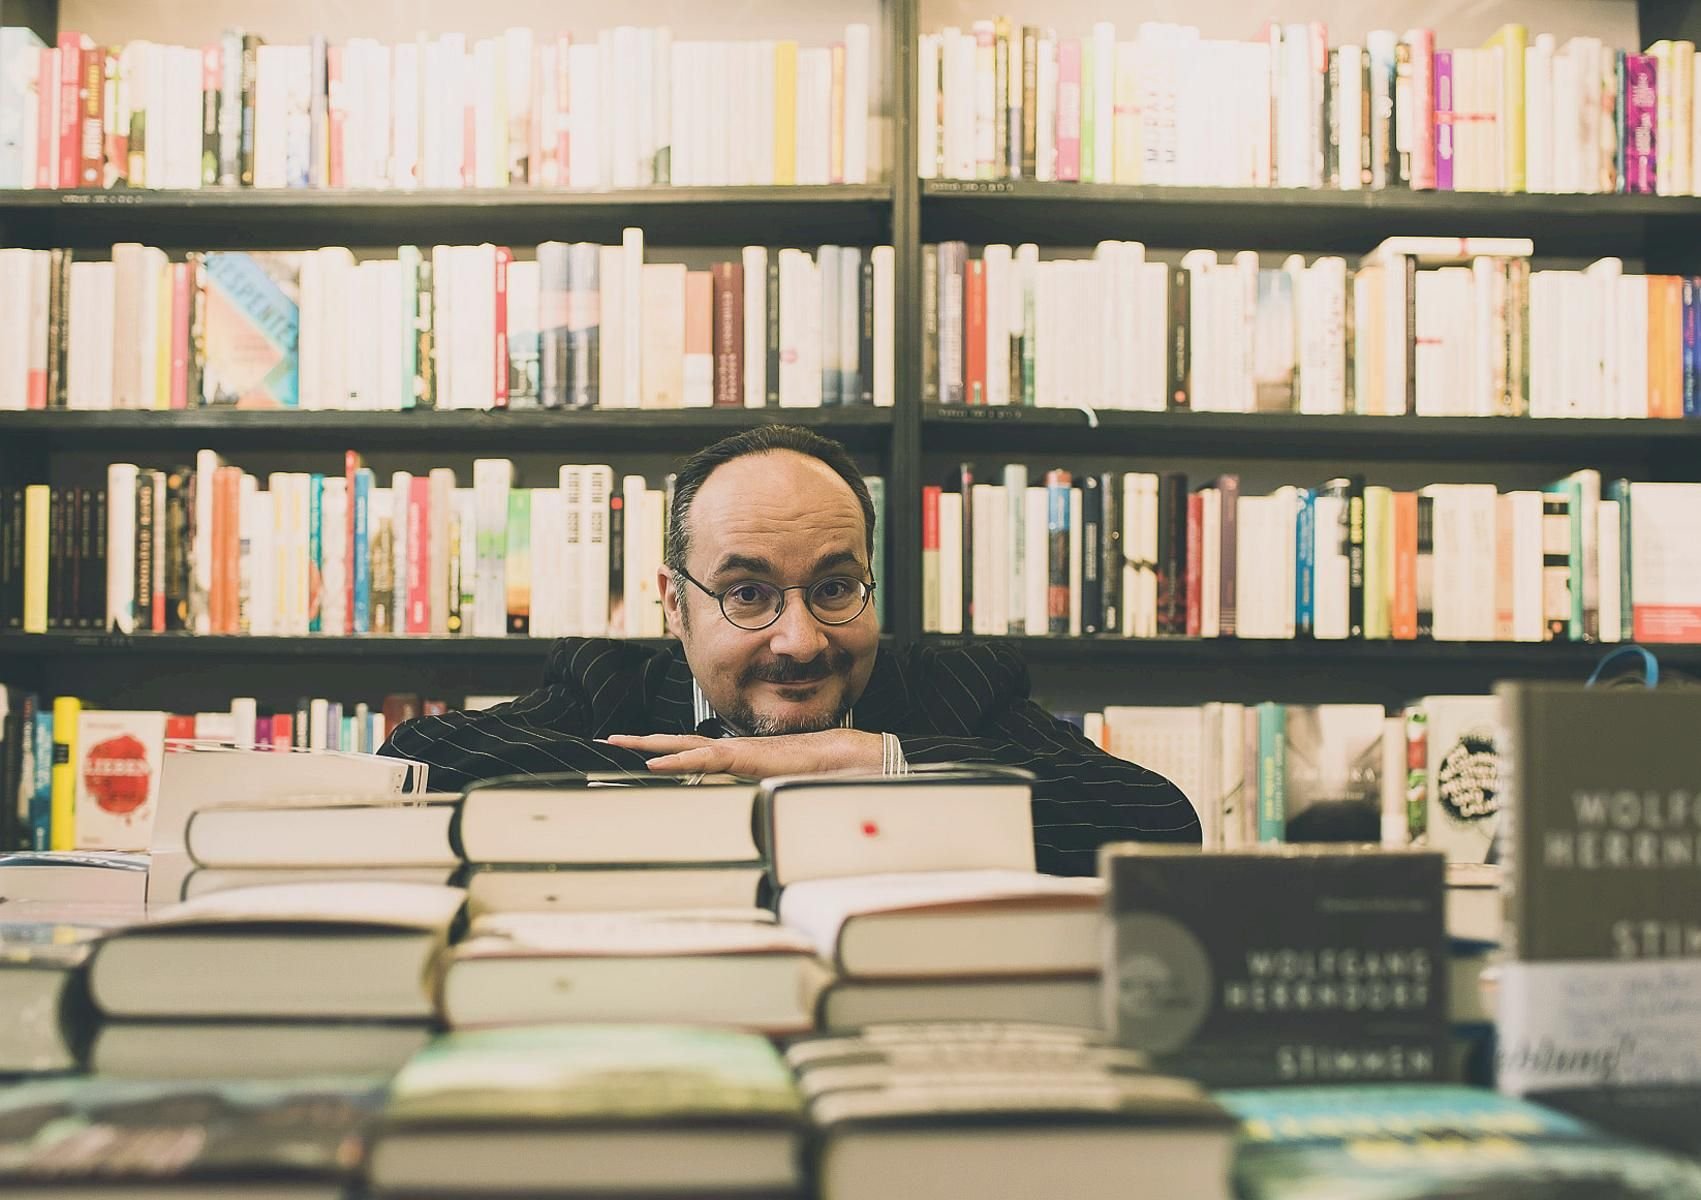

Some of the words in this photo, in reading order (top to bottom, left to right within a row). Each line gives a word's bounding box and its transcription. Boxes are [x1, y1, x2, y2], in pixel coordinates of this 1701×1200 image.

[1544, 831, 1701, 868] HERRN
[1247, 949, 1431, 979] WOLFGANG
[1225, 981, 1428, 1010] HERRNDORF
[1277, 1046, 1432, 1079] STIMMEN
